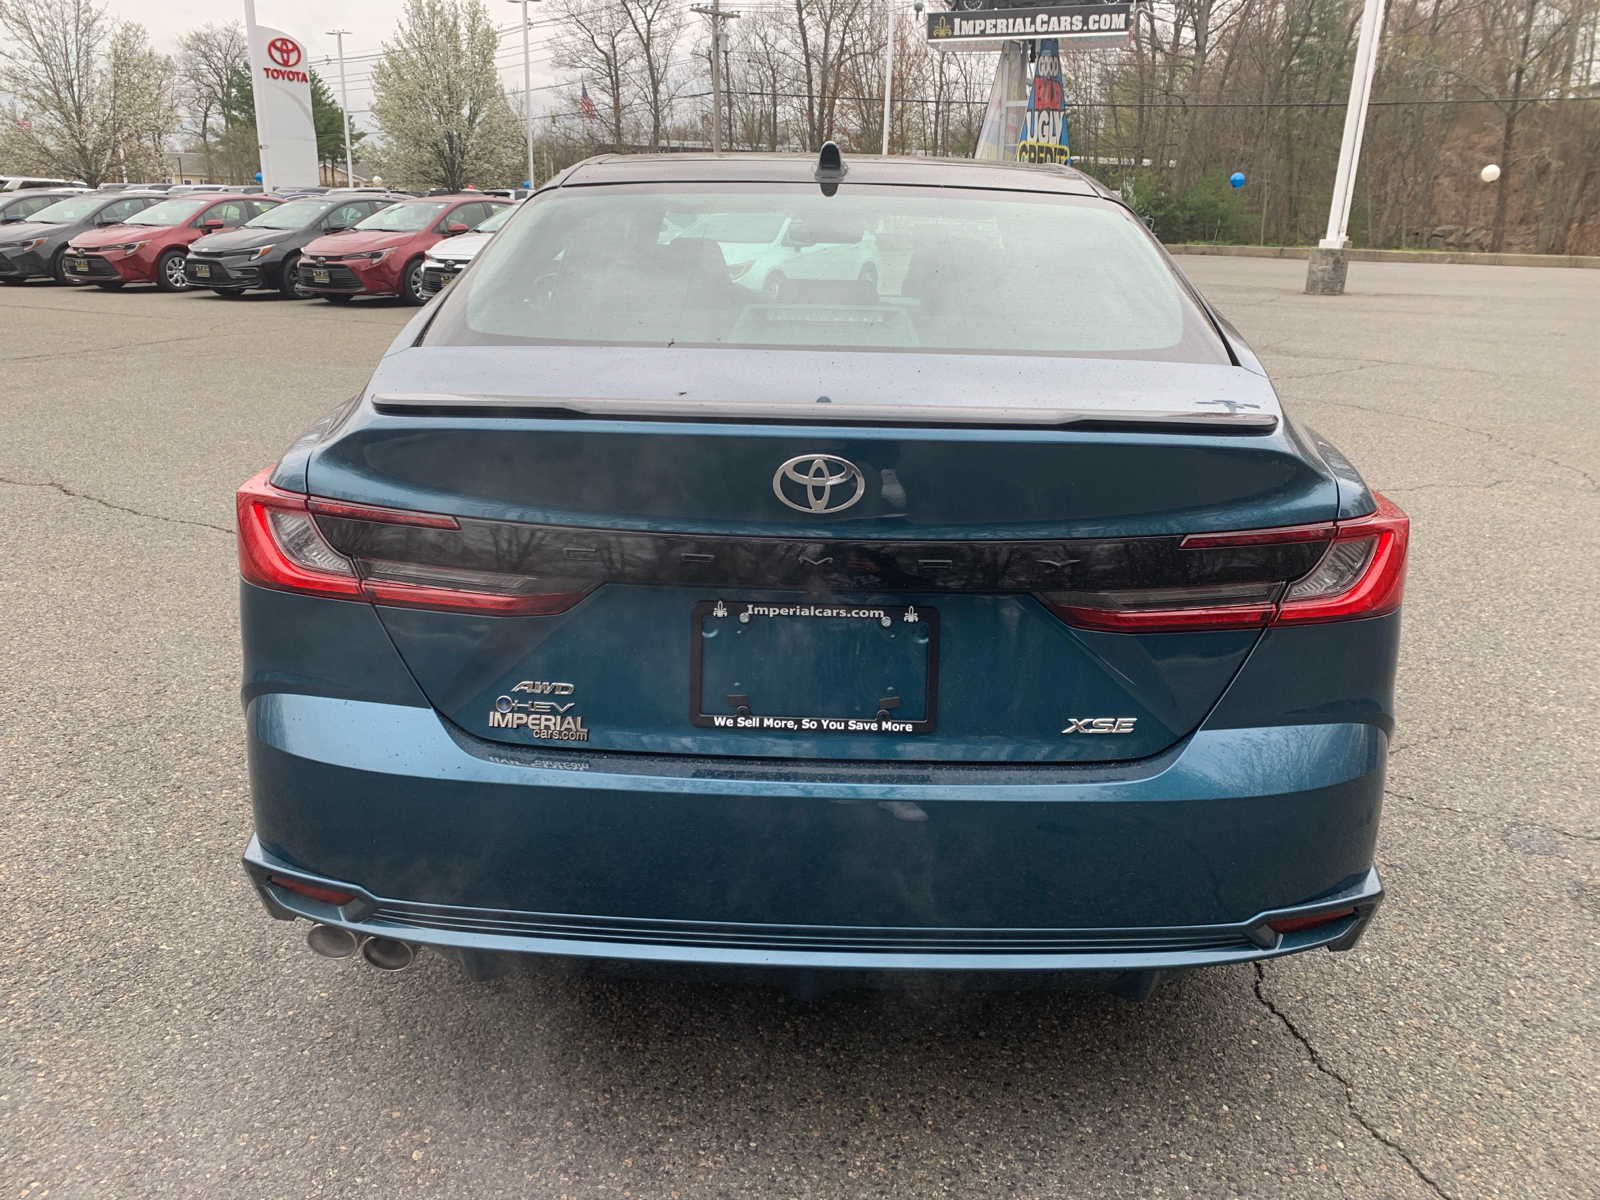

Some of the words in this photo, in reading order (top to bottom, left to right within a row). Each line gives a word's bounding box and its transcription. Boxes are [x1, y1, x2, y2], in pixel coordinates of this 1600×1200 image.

[1038, 56, 1059, 77] GOOD
[263, 67, 308, 83] TOYOTA
[1034, 77, 1062, 109] BAD
[1026, 110, 1064, 145] UGLY
[747, 604, 885, 618] Imperialcars.com
[511, 680, 575, 695] AWD
[512, 699, 576, 713] HEV
[488, 711, 589, 733] IMPERIAL
[713, 716, 734, 727] We
[737, 716, 760, 727] Sell
[763, 718, 798, 731] More,
[801, 718, 818, 729] So
[821, 719, 845, 730] You
[848, 720, 878, 731] Save
[882, 721, 913, 732] More
[1061, 717, 1138, 734] XSE
[533, 728, 588, 741] cars.com
